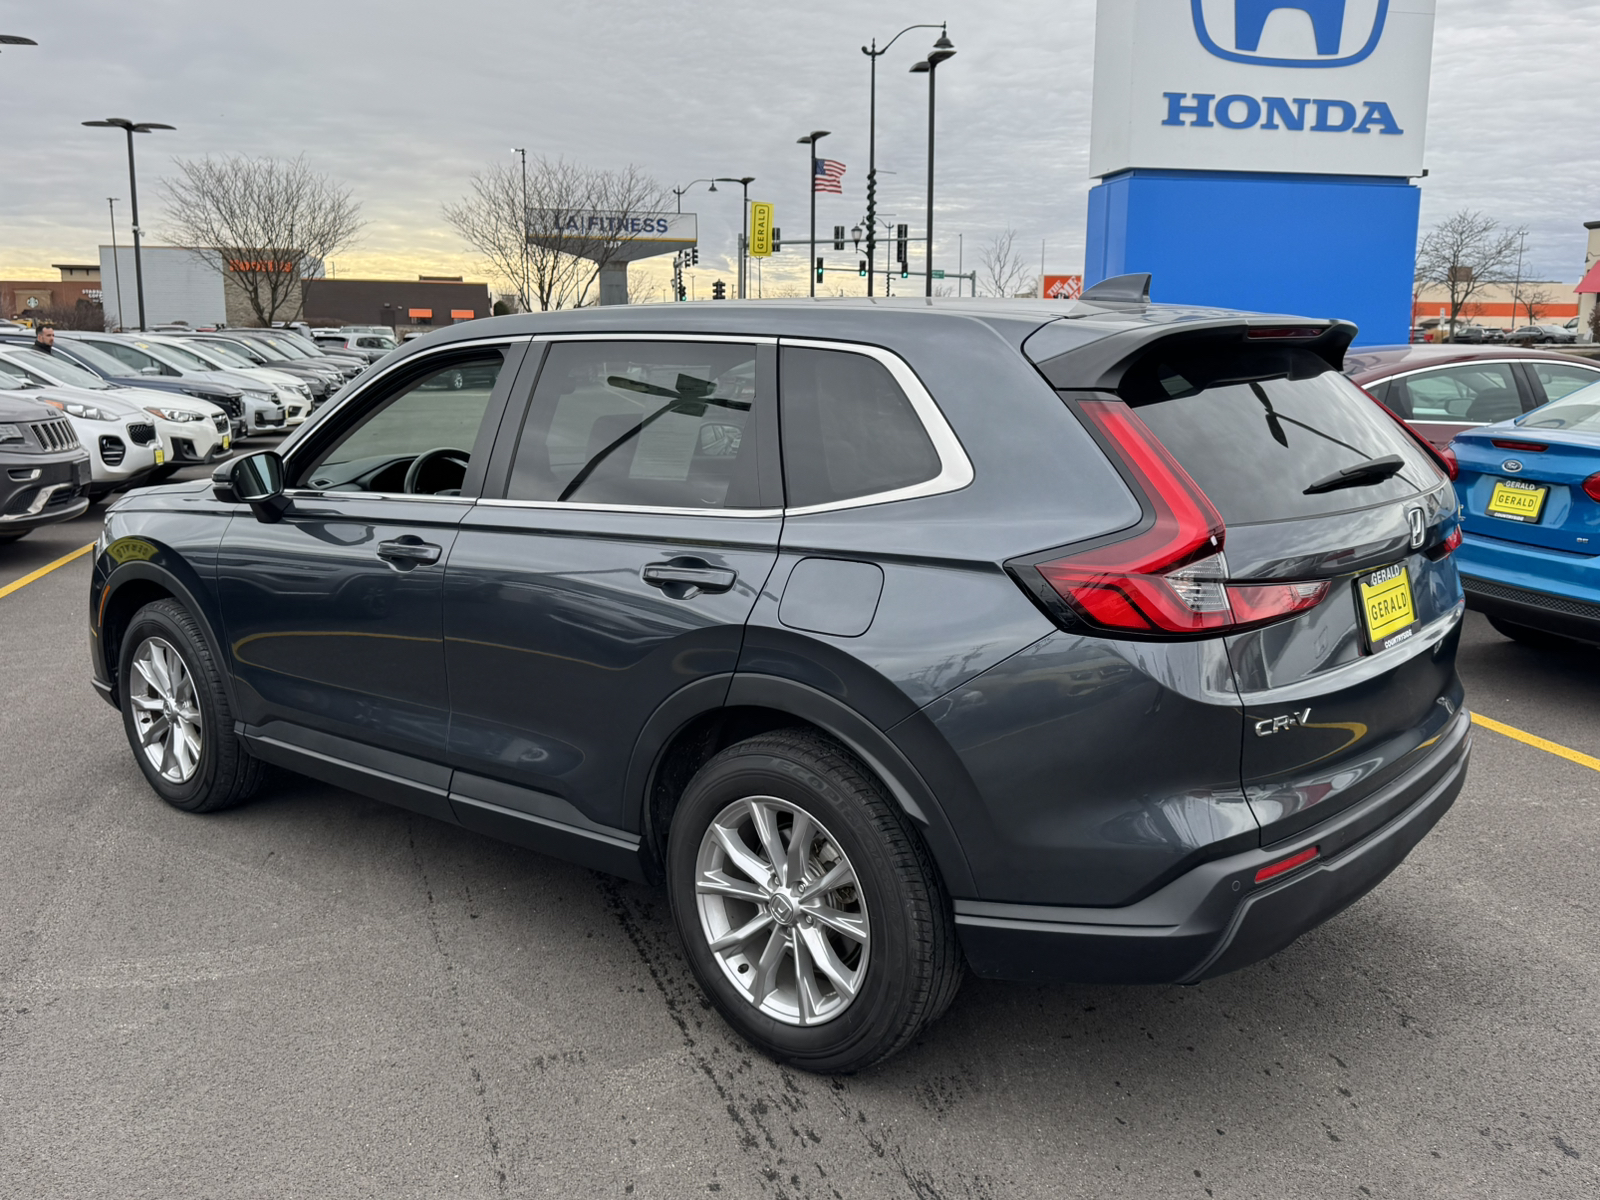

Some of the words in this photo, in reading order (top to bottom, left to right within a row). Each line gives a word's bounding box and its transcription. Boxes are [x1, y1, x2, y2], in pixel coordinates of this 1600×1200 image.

[1161, 91, 1404, 135] HONDA
[555, 213, 579, 232] LA
[588, 215, 669, 234] FITNESS
[757, 208, 766, 250] GERALD
[1505, 480, 1536, 491] GERALD
[1498, 494, 1535, 508] GERALD
[1371, 564, 1401, 586] GERALD
[1371, 592, 1408, 621] GERALD
[1384, 629, 1413, 649] COUNTRYSIDE
[1254, 707, 1312, 737] CR-V
[774, 757, 862, 829] ECOPIA
